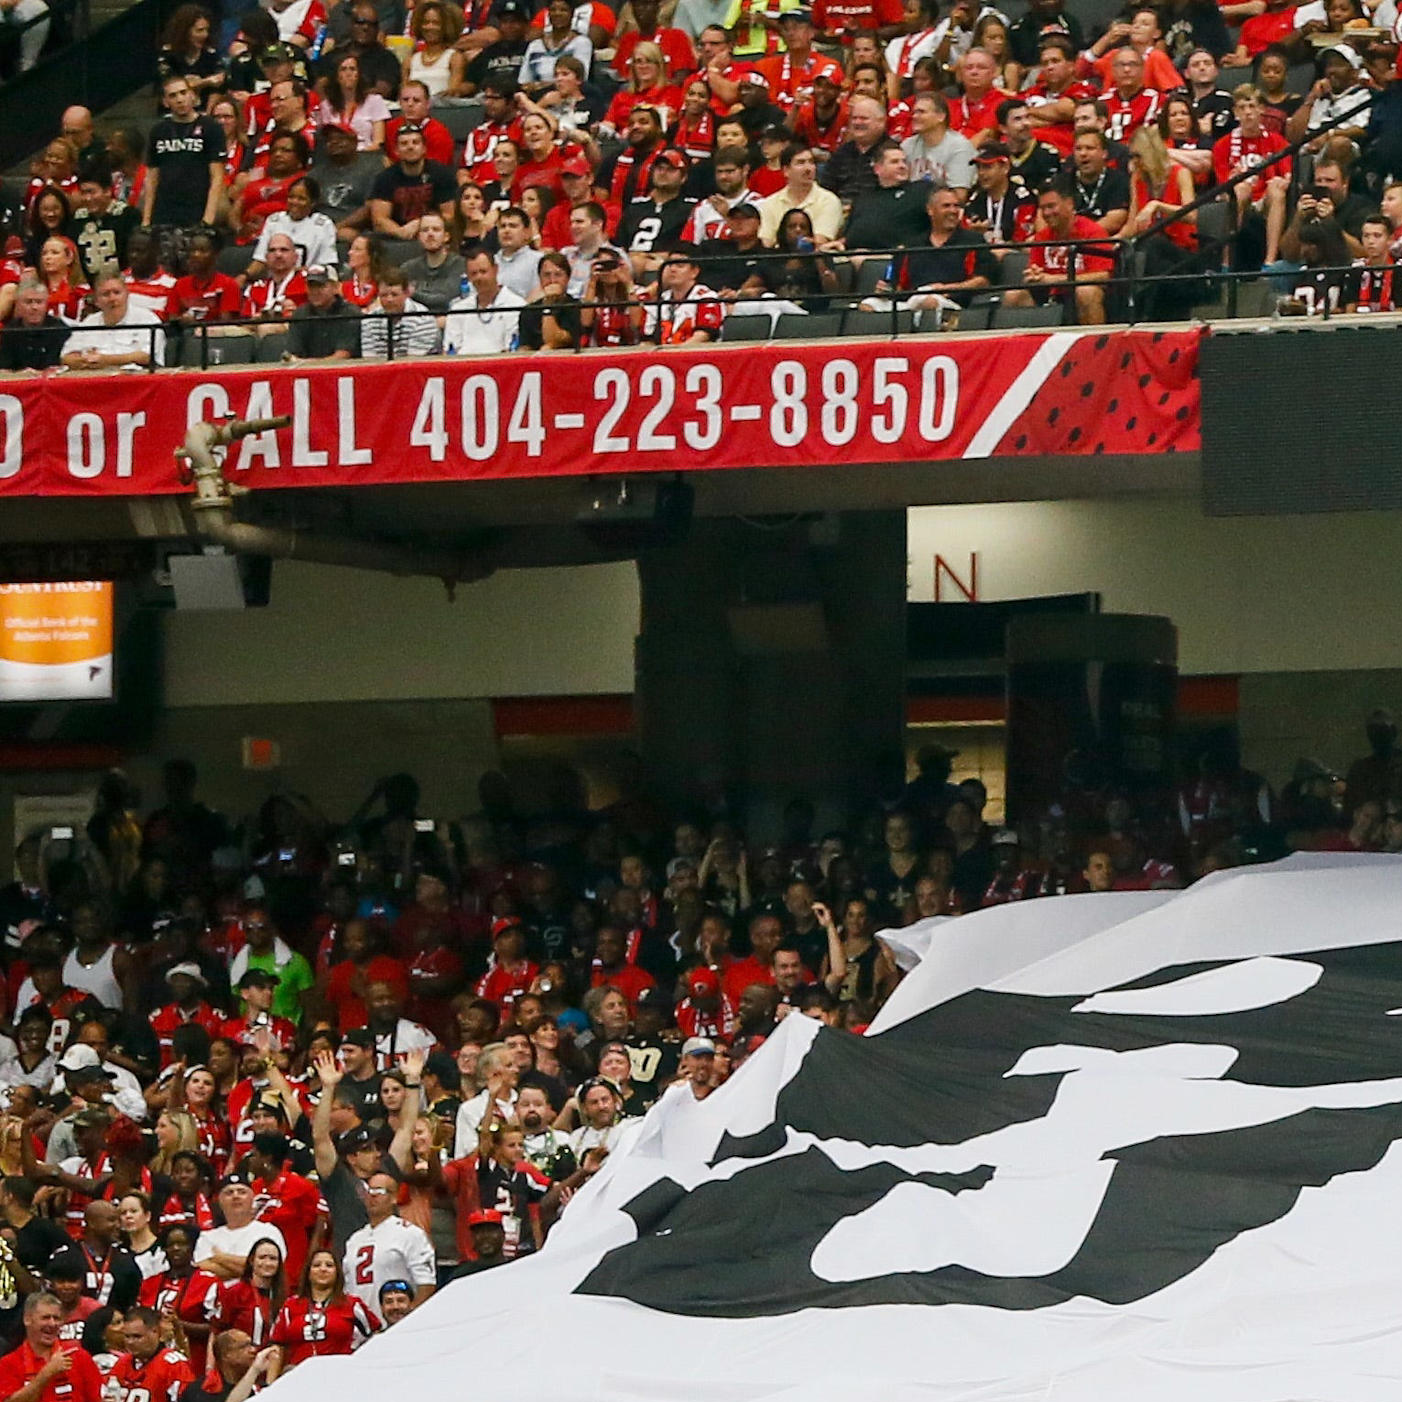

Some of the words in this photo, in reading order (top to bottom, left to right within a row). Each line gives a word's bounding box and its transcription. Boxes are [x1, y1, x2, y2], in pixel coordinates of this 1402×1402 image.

[155, 138, 204, 154] SAINTS
[629, 217, 663, 252] 2
[67, 407, 147, 479] or
[186, 375, 373, 473] CALL
[411, 355, 960, 464] 404-223-8850
[355, 1245, 375, 1285] 2
